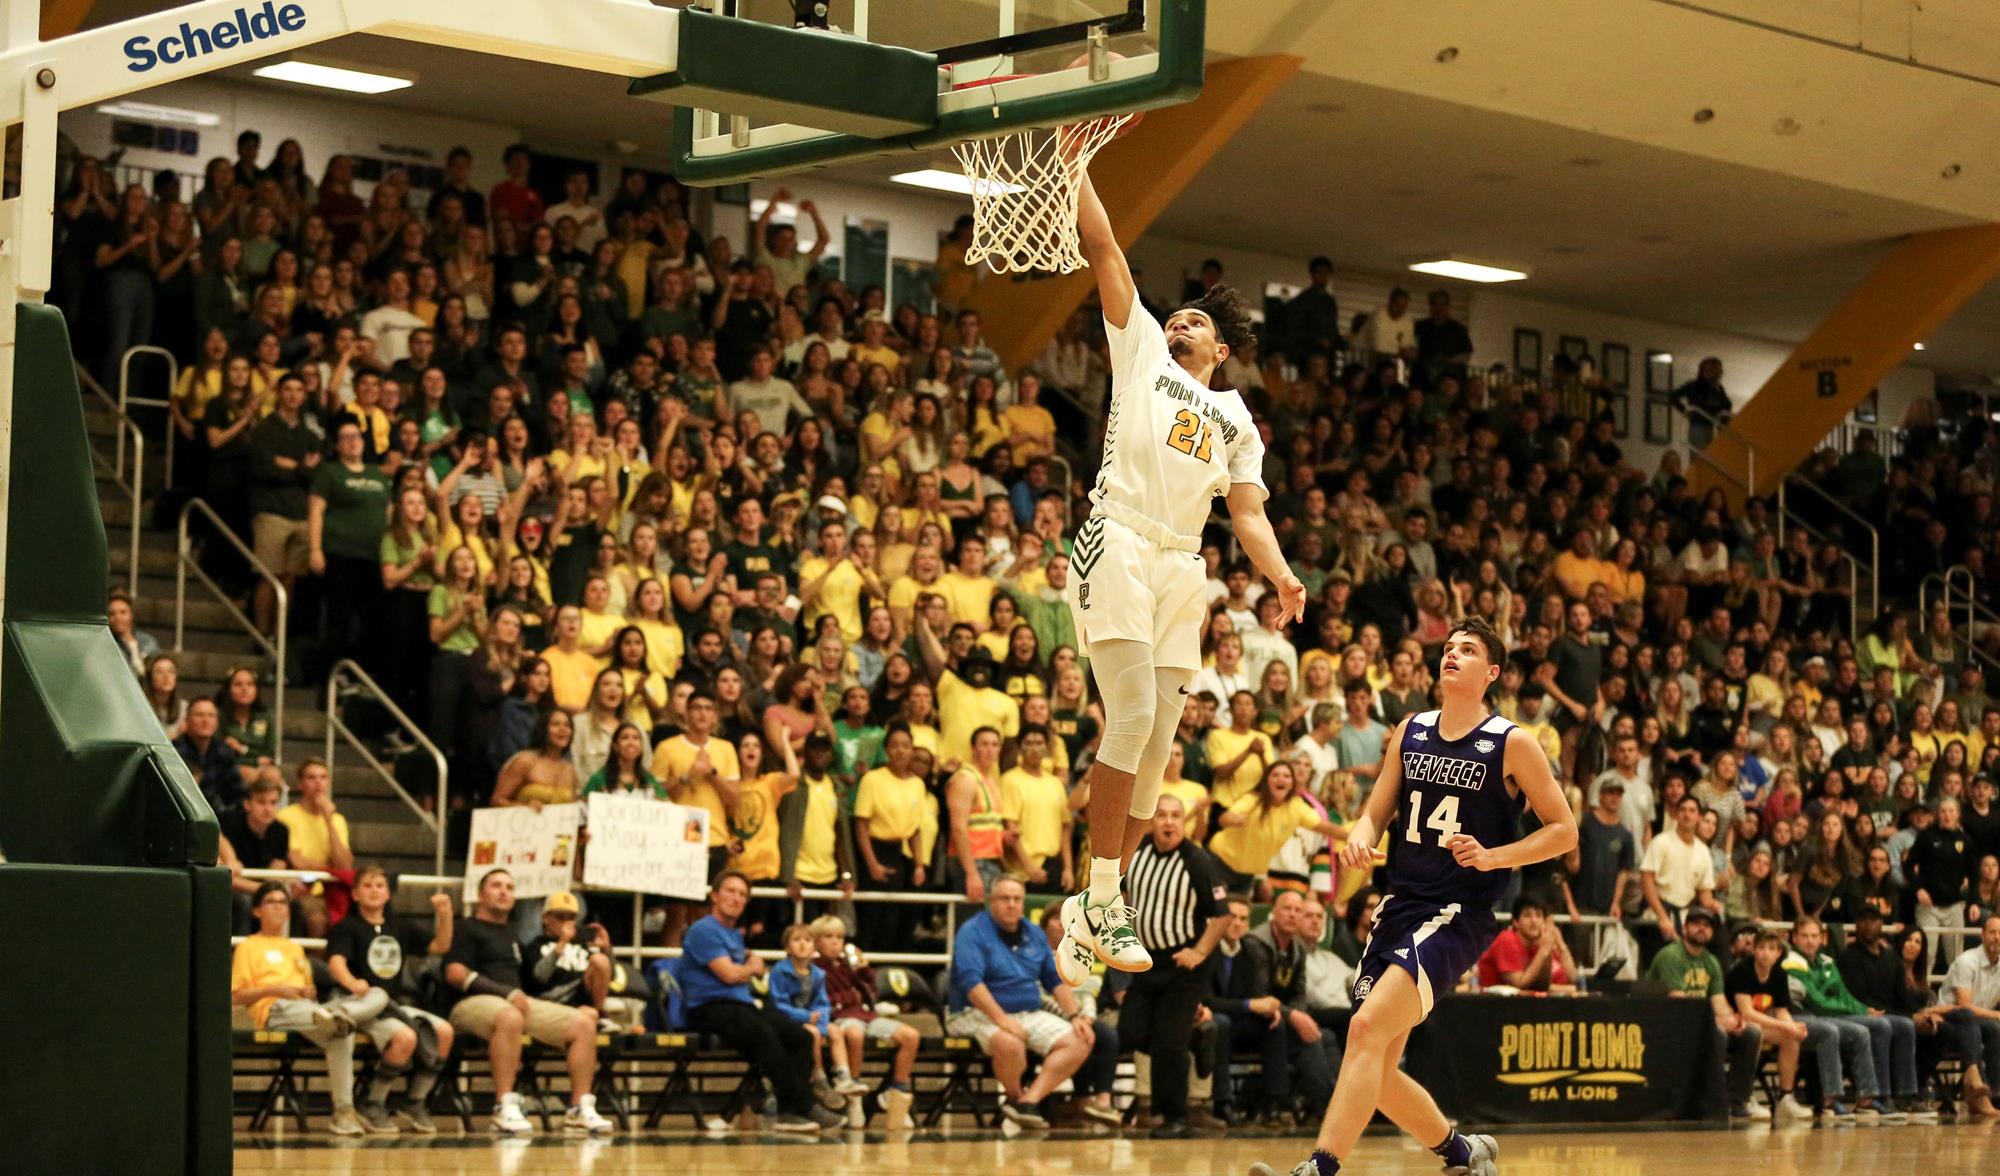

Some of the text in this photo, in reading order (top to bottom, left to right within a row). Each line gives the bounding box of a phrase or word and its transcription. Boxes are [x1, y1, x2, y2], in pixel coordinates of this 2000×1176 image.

[124, 1, 306, 72] Schelde
[1818, 371, 1838, 398] B
[1166, 409, 1212, 464] 21
[1403, 752, 1487, 791] TREVECCA
[1406, 790, 1462, 850] 14
[1499, 1021, 1646, 1072] POINT LOMA
[1530, 1085, 1619, 1101] SEA LIONS
